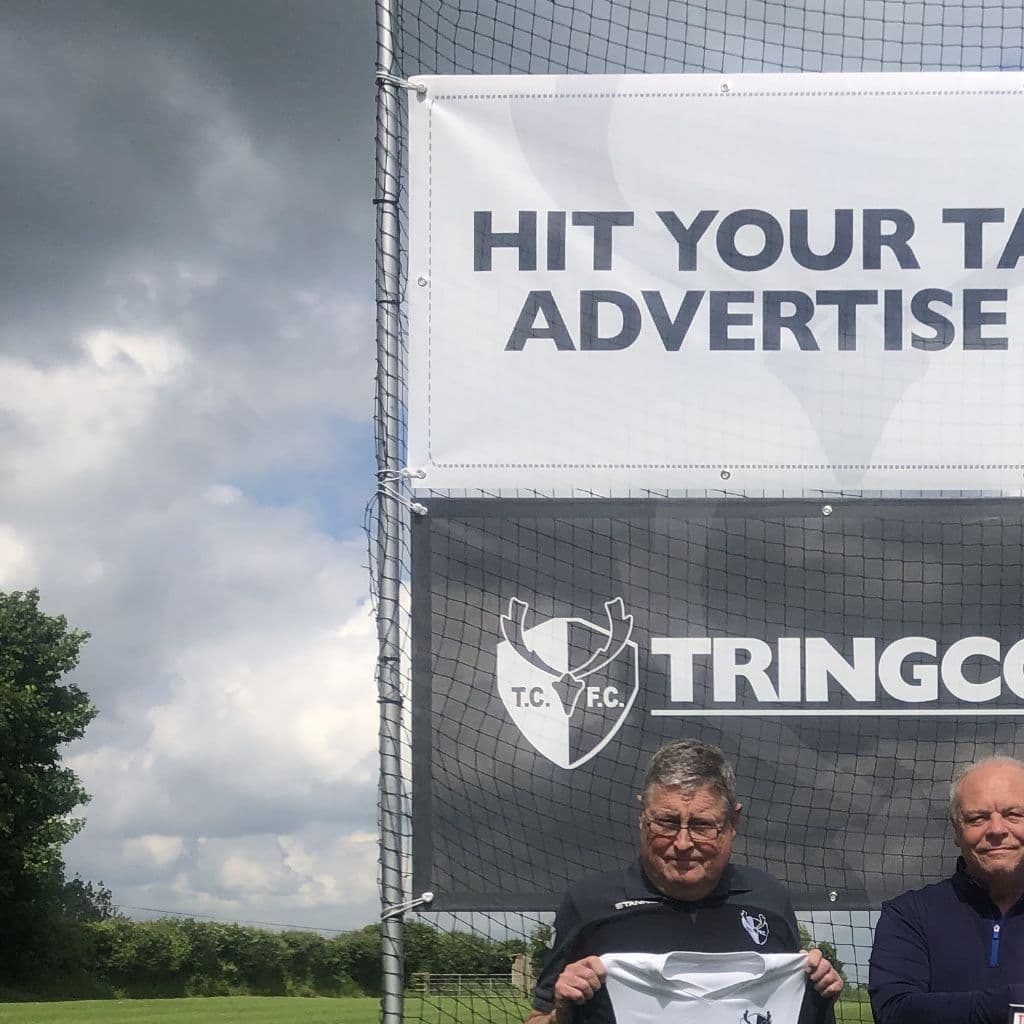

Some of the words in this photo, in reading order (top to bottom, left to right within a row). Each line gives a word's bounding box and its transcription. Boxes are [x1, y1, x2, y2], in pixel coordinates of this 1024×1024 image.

[474, 211, 634, 272] HIT
[656, 209, 920, 272] YOUR
[505, 288, 1008, 351] ADVERTISE
[511, 686, 550, 708] T.C.
[586, 686, 625, 708] F.C.
